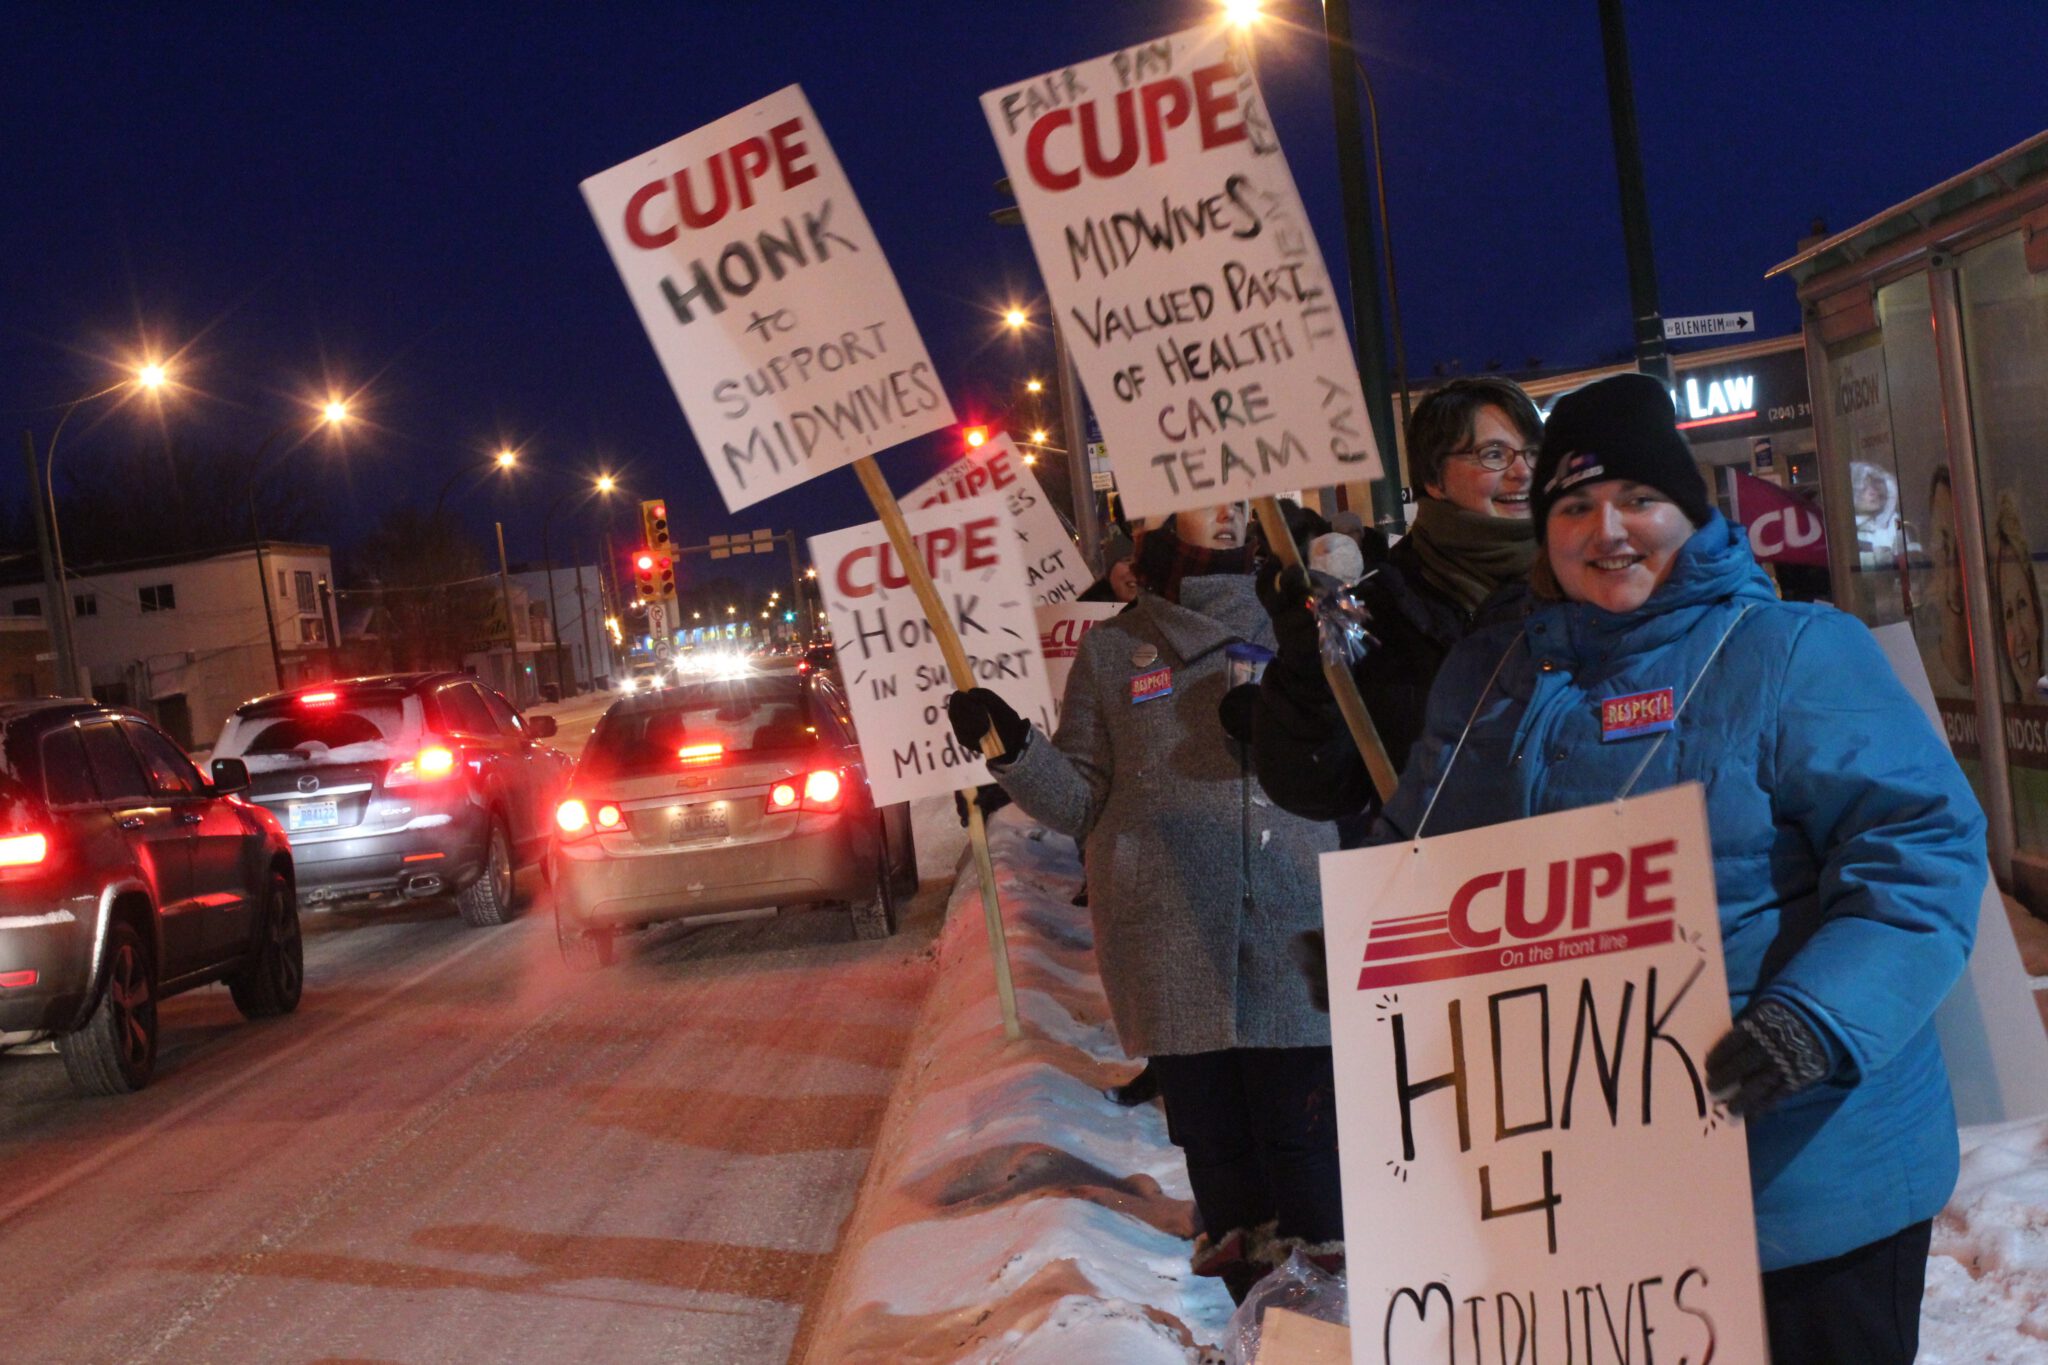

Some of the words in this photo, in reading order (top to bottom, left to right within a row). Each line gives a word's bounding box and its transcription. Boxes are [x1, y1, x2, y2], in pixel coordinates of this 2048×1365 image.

[1001, 67, 1087, 135] FAIR
[1111, 39, 1174, 88] PAY
[1024, 60, 1249, 193] CUPE
[623, 116, 820, 250] CUPE
[659, 198, 860, 325] HONK
[1064, 174, 1262, 282] MIDWIVES
[1071, 283, 1214, 348] VALUED
[1222, 259, 1313, 315] PART
[1674, 317, 1725, 336] BLENHEIM
[713, 321, 887, 419] SUPPORT
[1113, 364, 1146, 403] OF
[1157, 319, 1295, 386] HEALTH
[1686, 375, 1754, 419] LAW
[721, 361, 940, 491] MIDWIVES
[1157, 383, 1276, 444] CARE
[1797, 403, 1811, 416] 31
[919, 448, 1018, 511] PE
[1151, 429, 1312, 495] TEAM
[836, 515, 998, 600] CUPE
[1026, 550, 1065, 588] ACT
[1748, 506, 1822, 557] CU
[872, 678, 898, 701] IN
[915, 648, 1032, 692] SUPORT
[1050, 618, 1098, 648] CU
[1608, 692, 1668, 724] RESPECT!
[1447, 838, 1679, 948] CUPE
[1500, 949, 1524, 967] On
[1529, 945, 1553, 962] the
[1558, 936, 1595, 958] front
[1599, 932, 1629, 951] line
[1391, 959, 1708, 1163] HONK
[1478, 1149, 1563, 1255] 4
